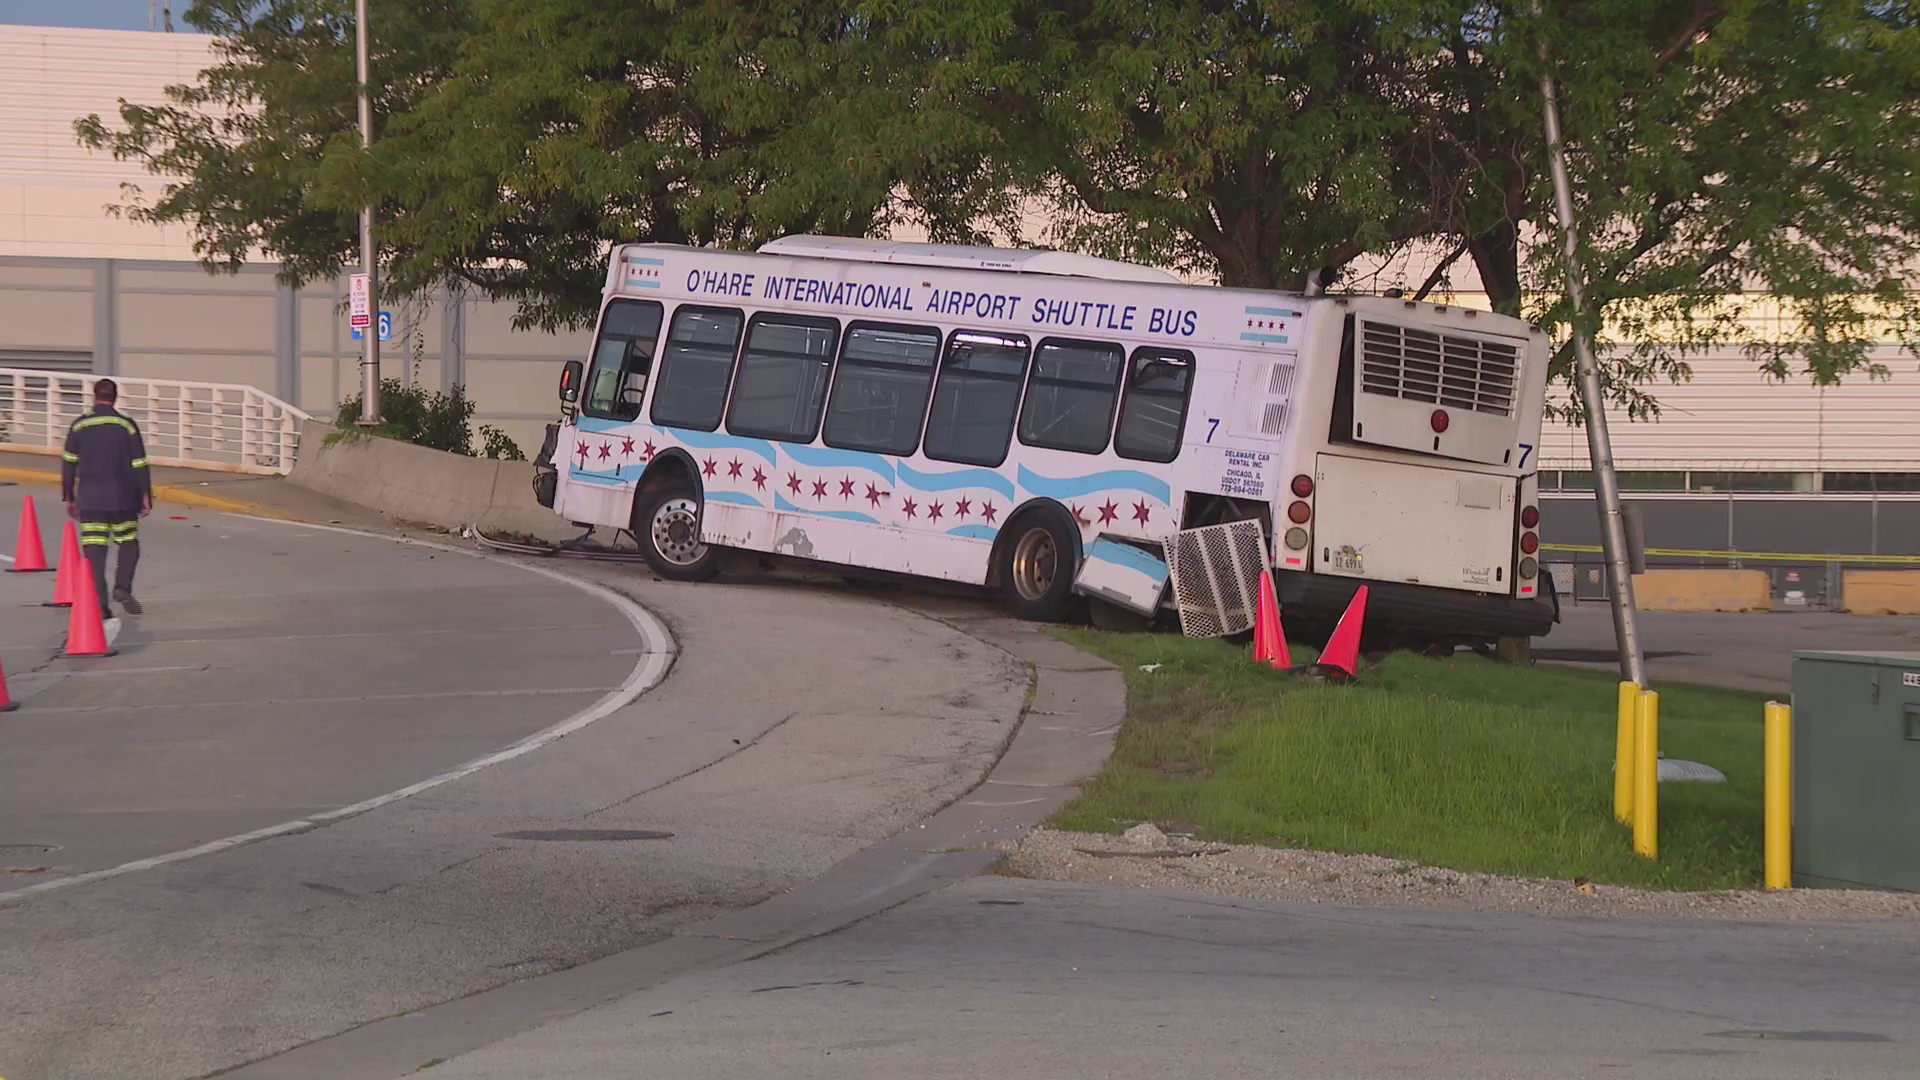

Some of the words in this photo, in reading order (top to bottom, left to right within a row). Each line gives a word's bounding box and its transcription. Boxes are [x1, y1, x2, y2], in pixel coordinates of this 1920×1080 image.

[687, 269, 755, 297] O'HARE
[764, 275, 913, 311] INTERNATIONAL
[926, 288, 1021, 321] AIRPORT
[1031, 298, 1137, 332] SHUTTLE
[1148, 307, 1198, 337] BUS
[1206, 418, 1220, 443] 7
[1225, 450, 1256, 460] DELAWARE
[1229, 459, 1250, 467] RENTAL
[1518, 443, 1533, 469] 7
[1221, 476, 1241, 485] USDOT
